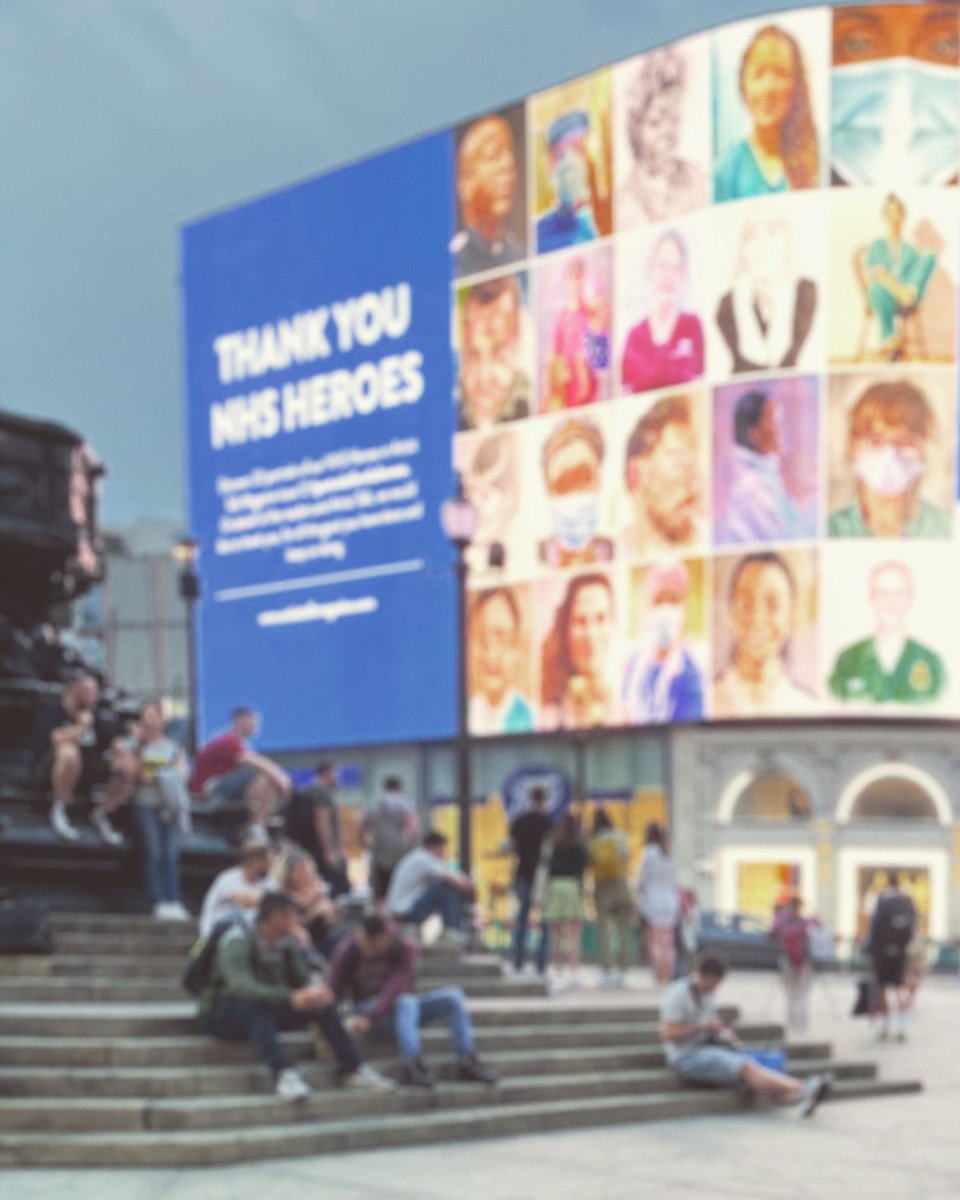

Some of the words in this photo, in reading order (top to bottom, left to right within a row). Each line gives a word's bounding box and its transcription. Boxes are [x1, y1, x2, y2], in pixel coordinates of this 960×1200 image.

[213, 305, 331, 384] THANK
[332, 281, 412, 352] YOU
[210, 387, 280, 449] NHS
[281, 350, 424, 433] HEROES
